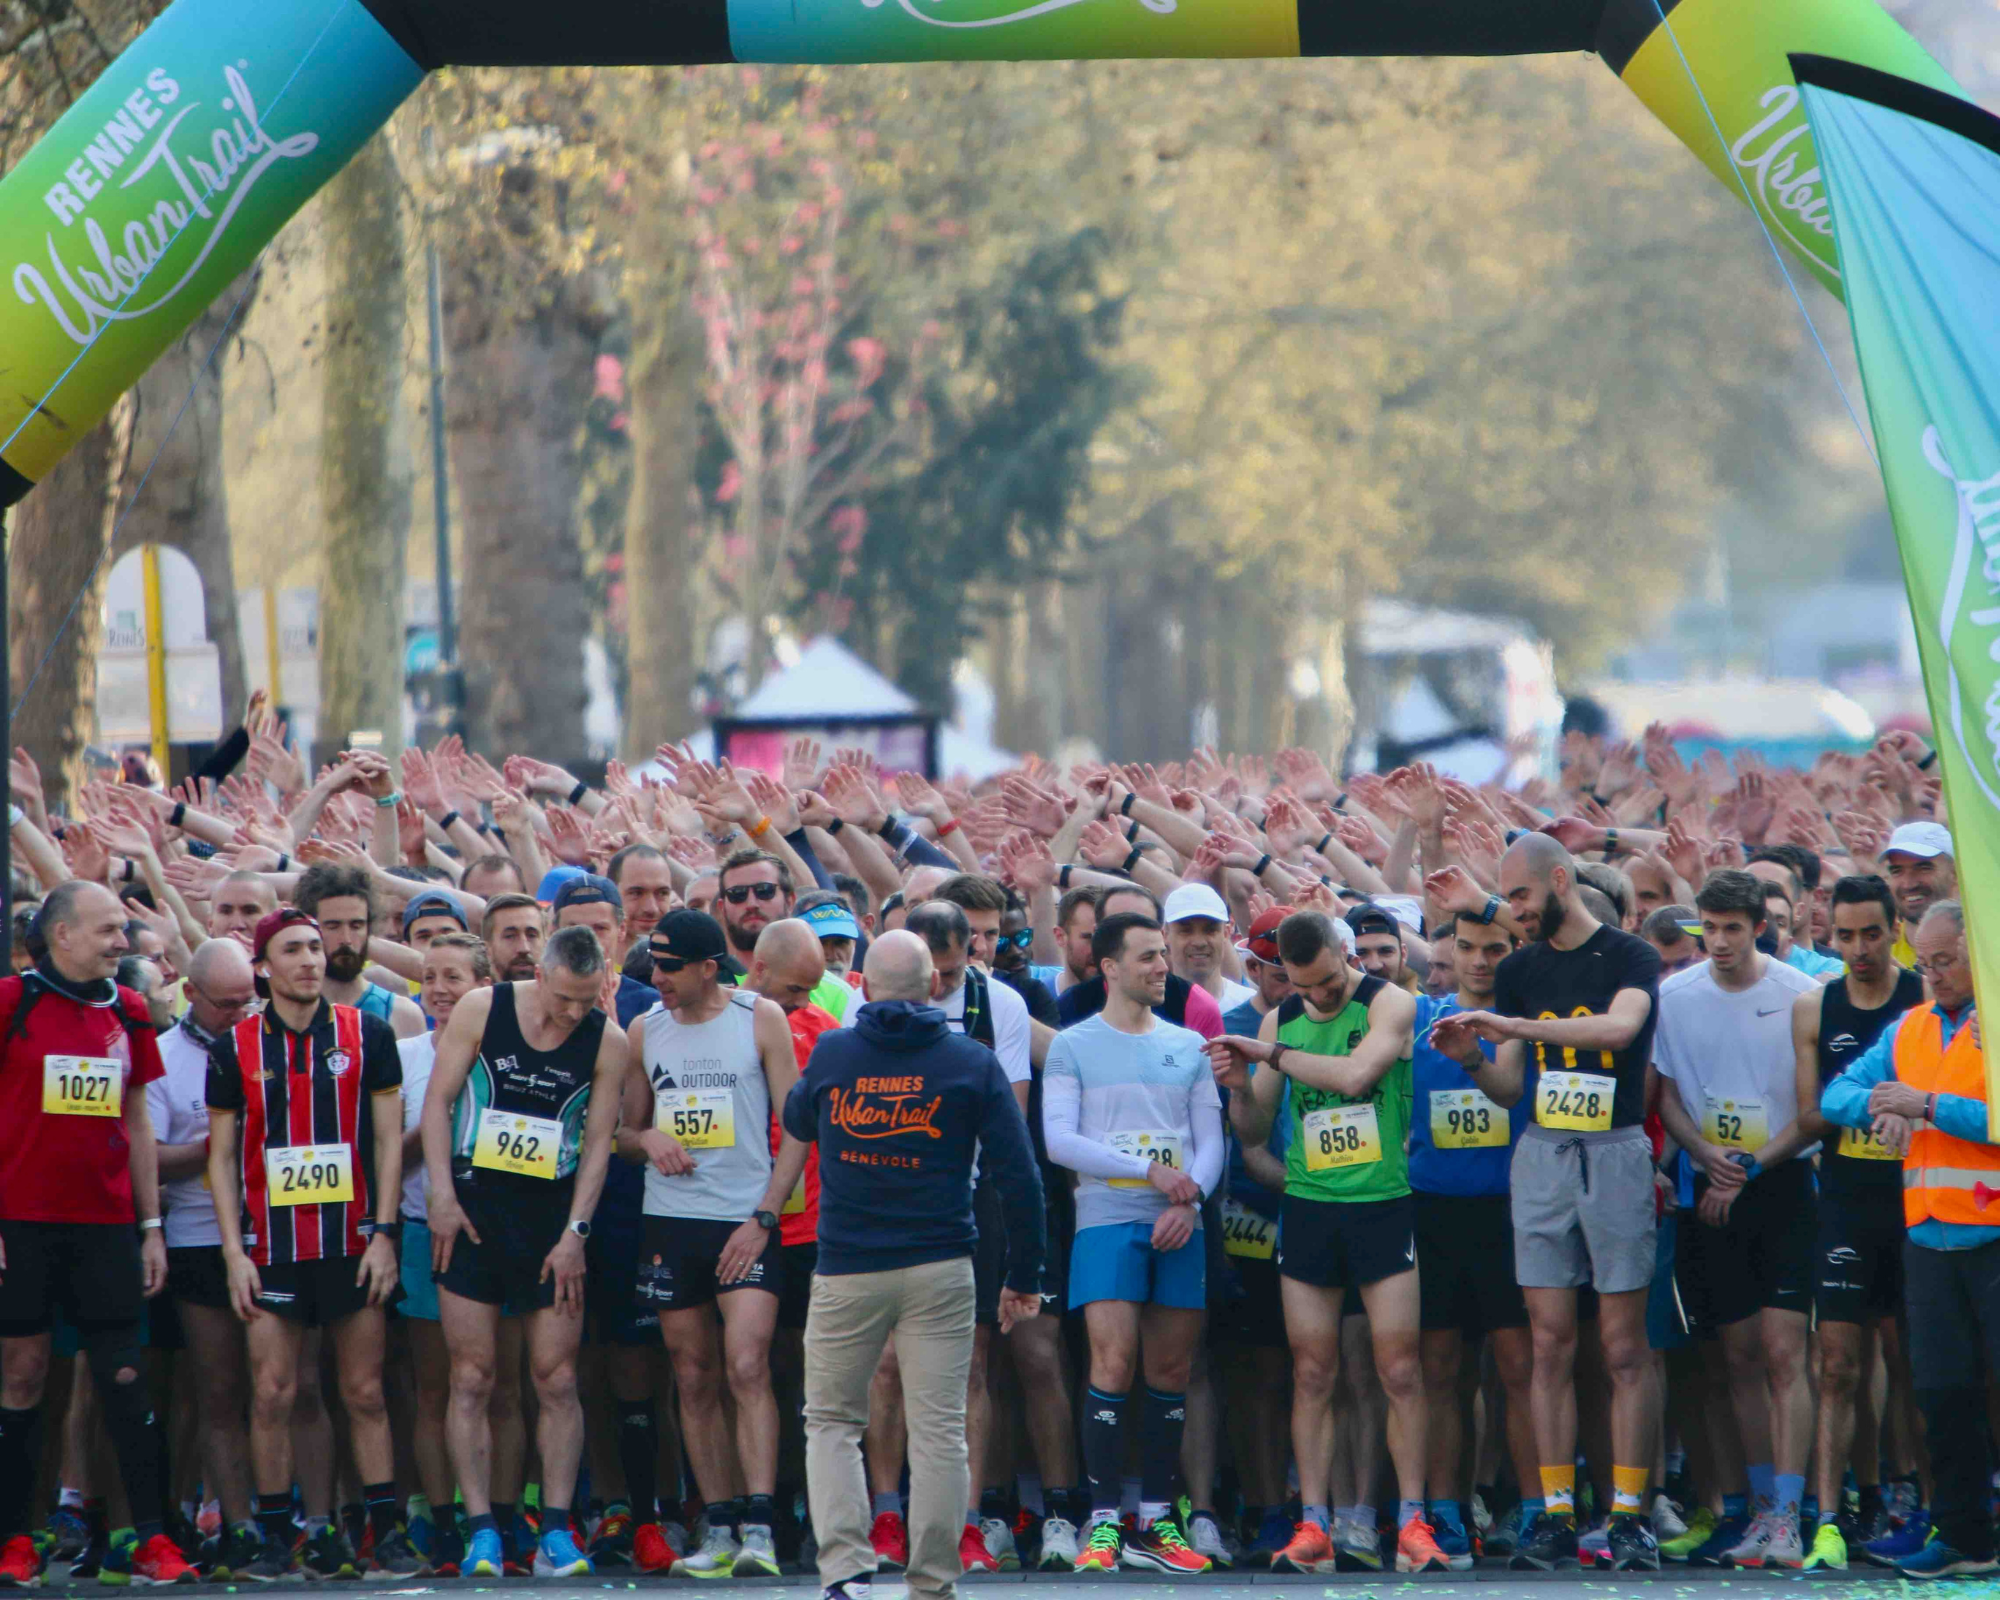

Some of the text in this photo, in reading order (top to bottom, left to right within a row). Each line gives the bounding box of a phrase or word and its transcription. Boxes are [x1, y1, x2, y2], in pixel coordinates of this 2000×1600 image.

[44, 67, 180, 227] RENNES
[683, 1059, 722, 1071] tonton
[58, 1074, 110, 1102] 1027
[681, 1073, 737, 1088] OUTDOOR
[855, 1076, 924, 1093] RENNES
[1546, 1089, 1600, 1118] 2428
[674, 1109, 713, 1136] 557
[1448, 1108, 1490, 1135] 983
[1718, 1114, 1742, 1141] 52
[497, 1131, 539, 1162] 962
[1319, 1125, 1360, 1155] 858
[1120, 1148, 1173, 1169] 38
[281, 1163, 339, 1192] 2490
[1223, 1216, 1268, 1246] 2444
